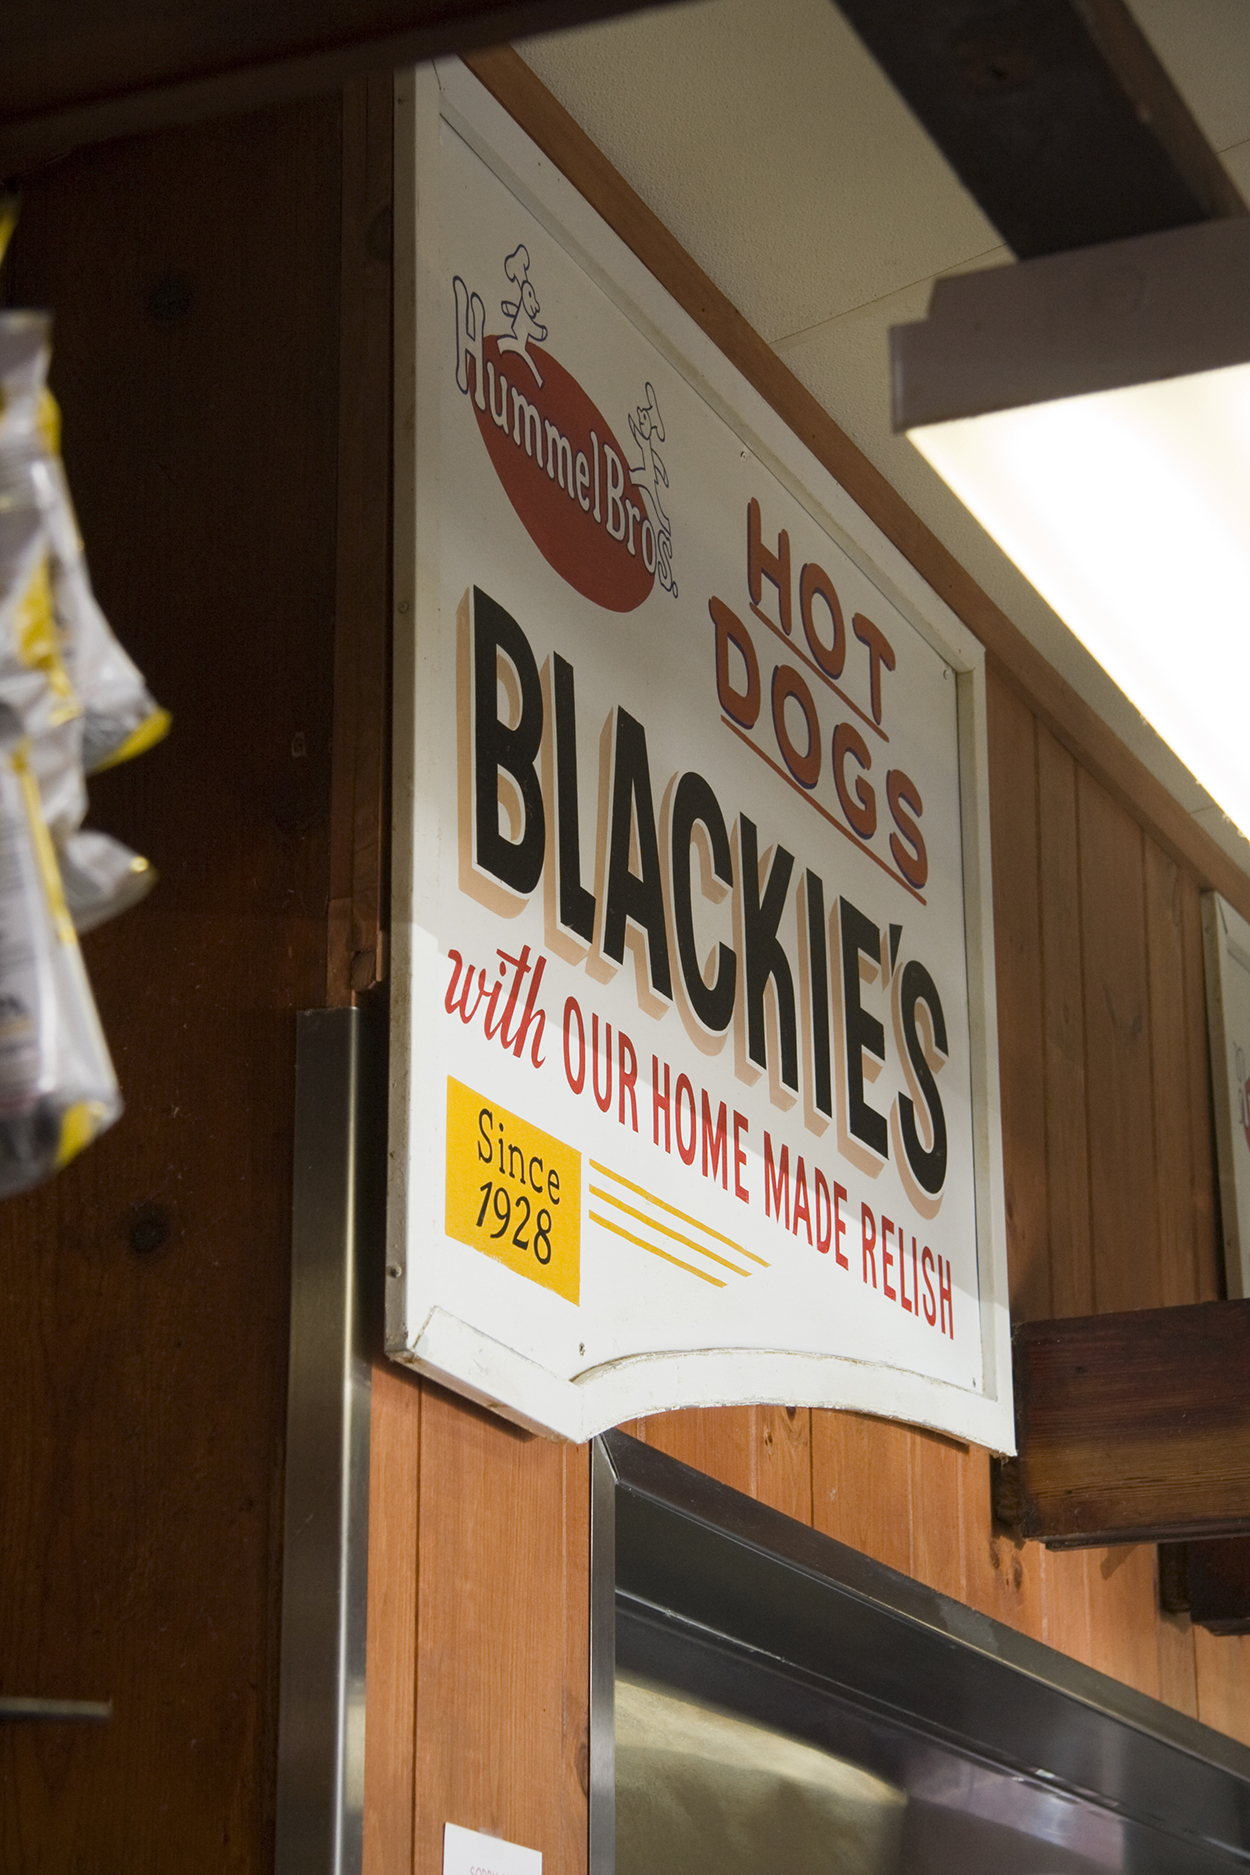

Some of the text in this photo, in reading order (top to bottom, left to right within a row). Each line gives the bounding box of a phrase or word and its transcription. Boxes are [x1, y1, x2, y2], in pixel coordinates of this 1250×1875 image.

[452, 275, 602, 524] Hummel
[747, 496, 897, 727] HOT
[708, 595, 930, 891] DOGS
[457, 584, 950, 1220] BLACKIE'S
[444, 944, 955, 1341] with OUR HOME MADE RELISH
[475, 1181, 552, 1266] 1928
[476, 1107, 561, 1206] Since
